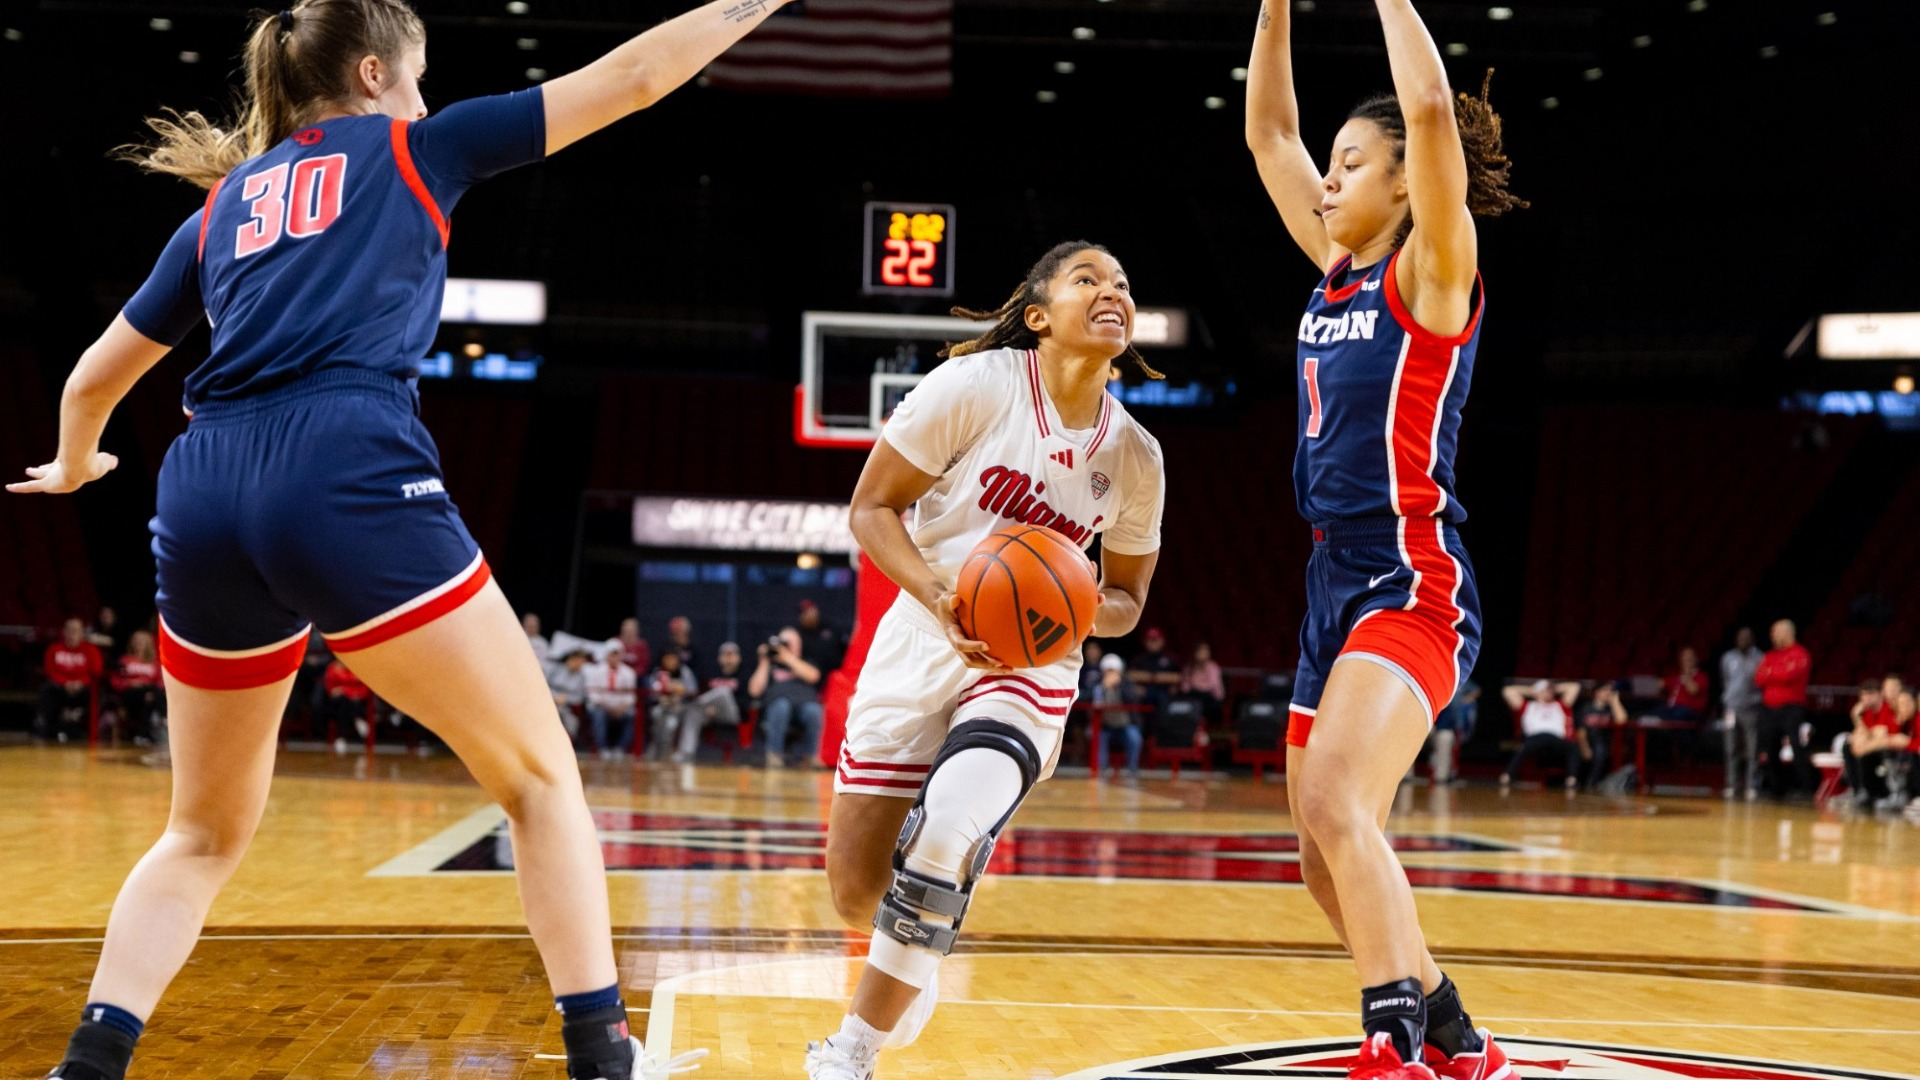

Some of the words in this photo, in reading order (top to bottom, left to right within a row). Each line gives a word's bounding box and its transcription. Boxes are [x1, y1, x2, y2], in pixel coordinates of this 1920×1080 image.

[234, 153, 348, 260] 30
[881, 239, 937, 287] 22
[1304, 357, 1322, 438] 1
[978, 465, 1104, 549] Miami
